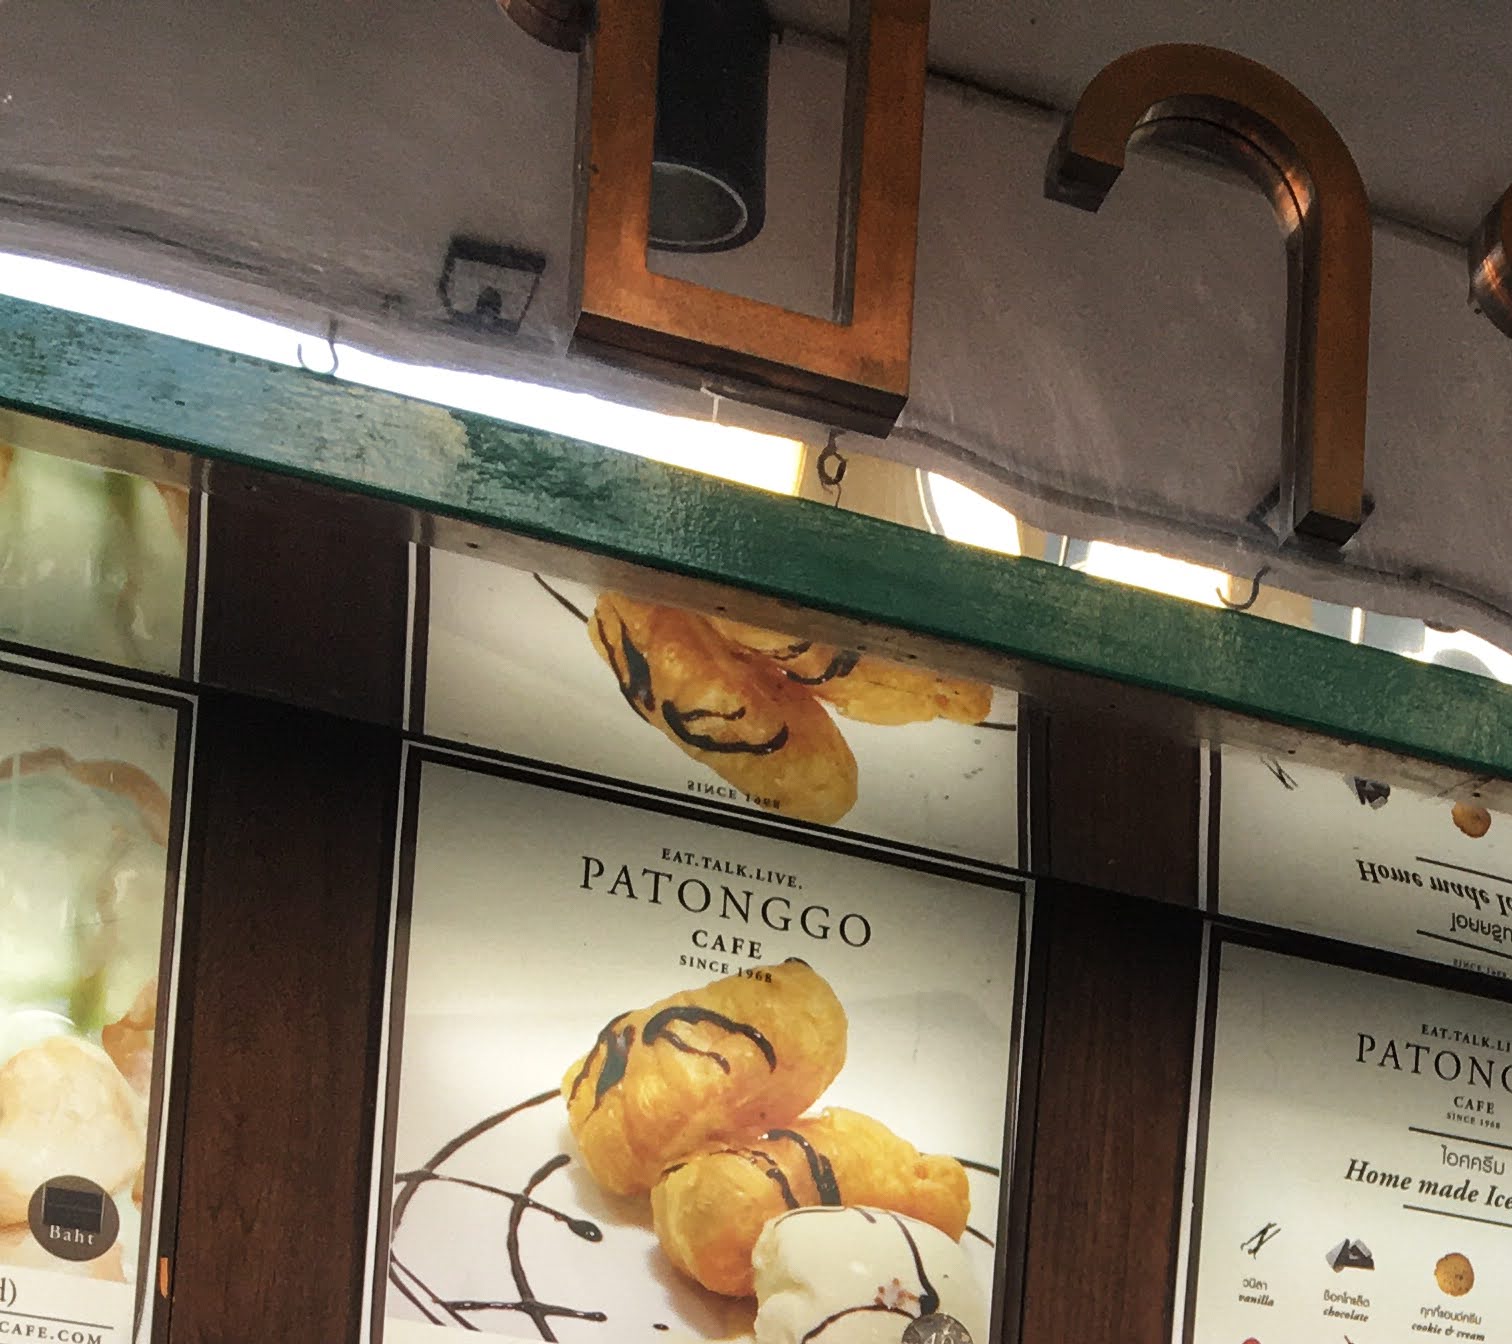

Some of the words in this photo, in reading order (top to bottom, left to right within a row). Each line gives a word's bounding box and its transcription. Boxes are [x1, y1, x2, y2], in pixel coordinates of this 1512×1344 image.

[660, 848, 803, 890] EAT.TALK.LIVE.
[580, 856, 872, 948] PATONGGO
[691, 930, 763, 960] CAFE
[679, 954, 730, 977] SINCE
[737, 966, 774, 985] 1968
[1446, 1111, 1476, 1126] SINCE
[1453, 1096, 1496, 1115] CAFE
[1344, 1159, 1412, 1193] Home
[1418, 1175, 1480, 1207] made
[49, 1224, 95, 1246] Baht
[1323, 1306, 1369, 1323] chocolate
[1411, 1321, 1443, 1336] cookie
[1456, 1329, 1486, 1343] cream
